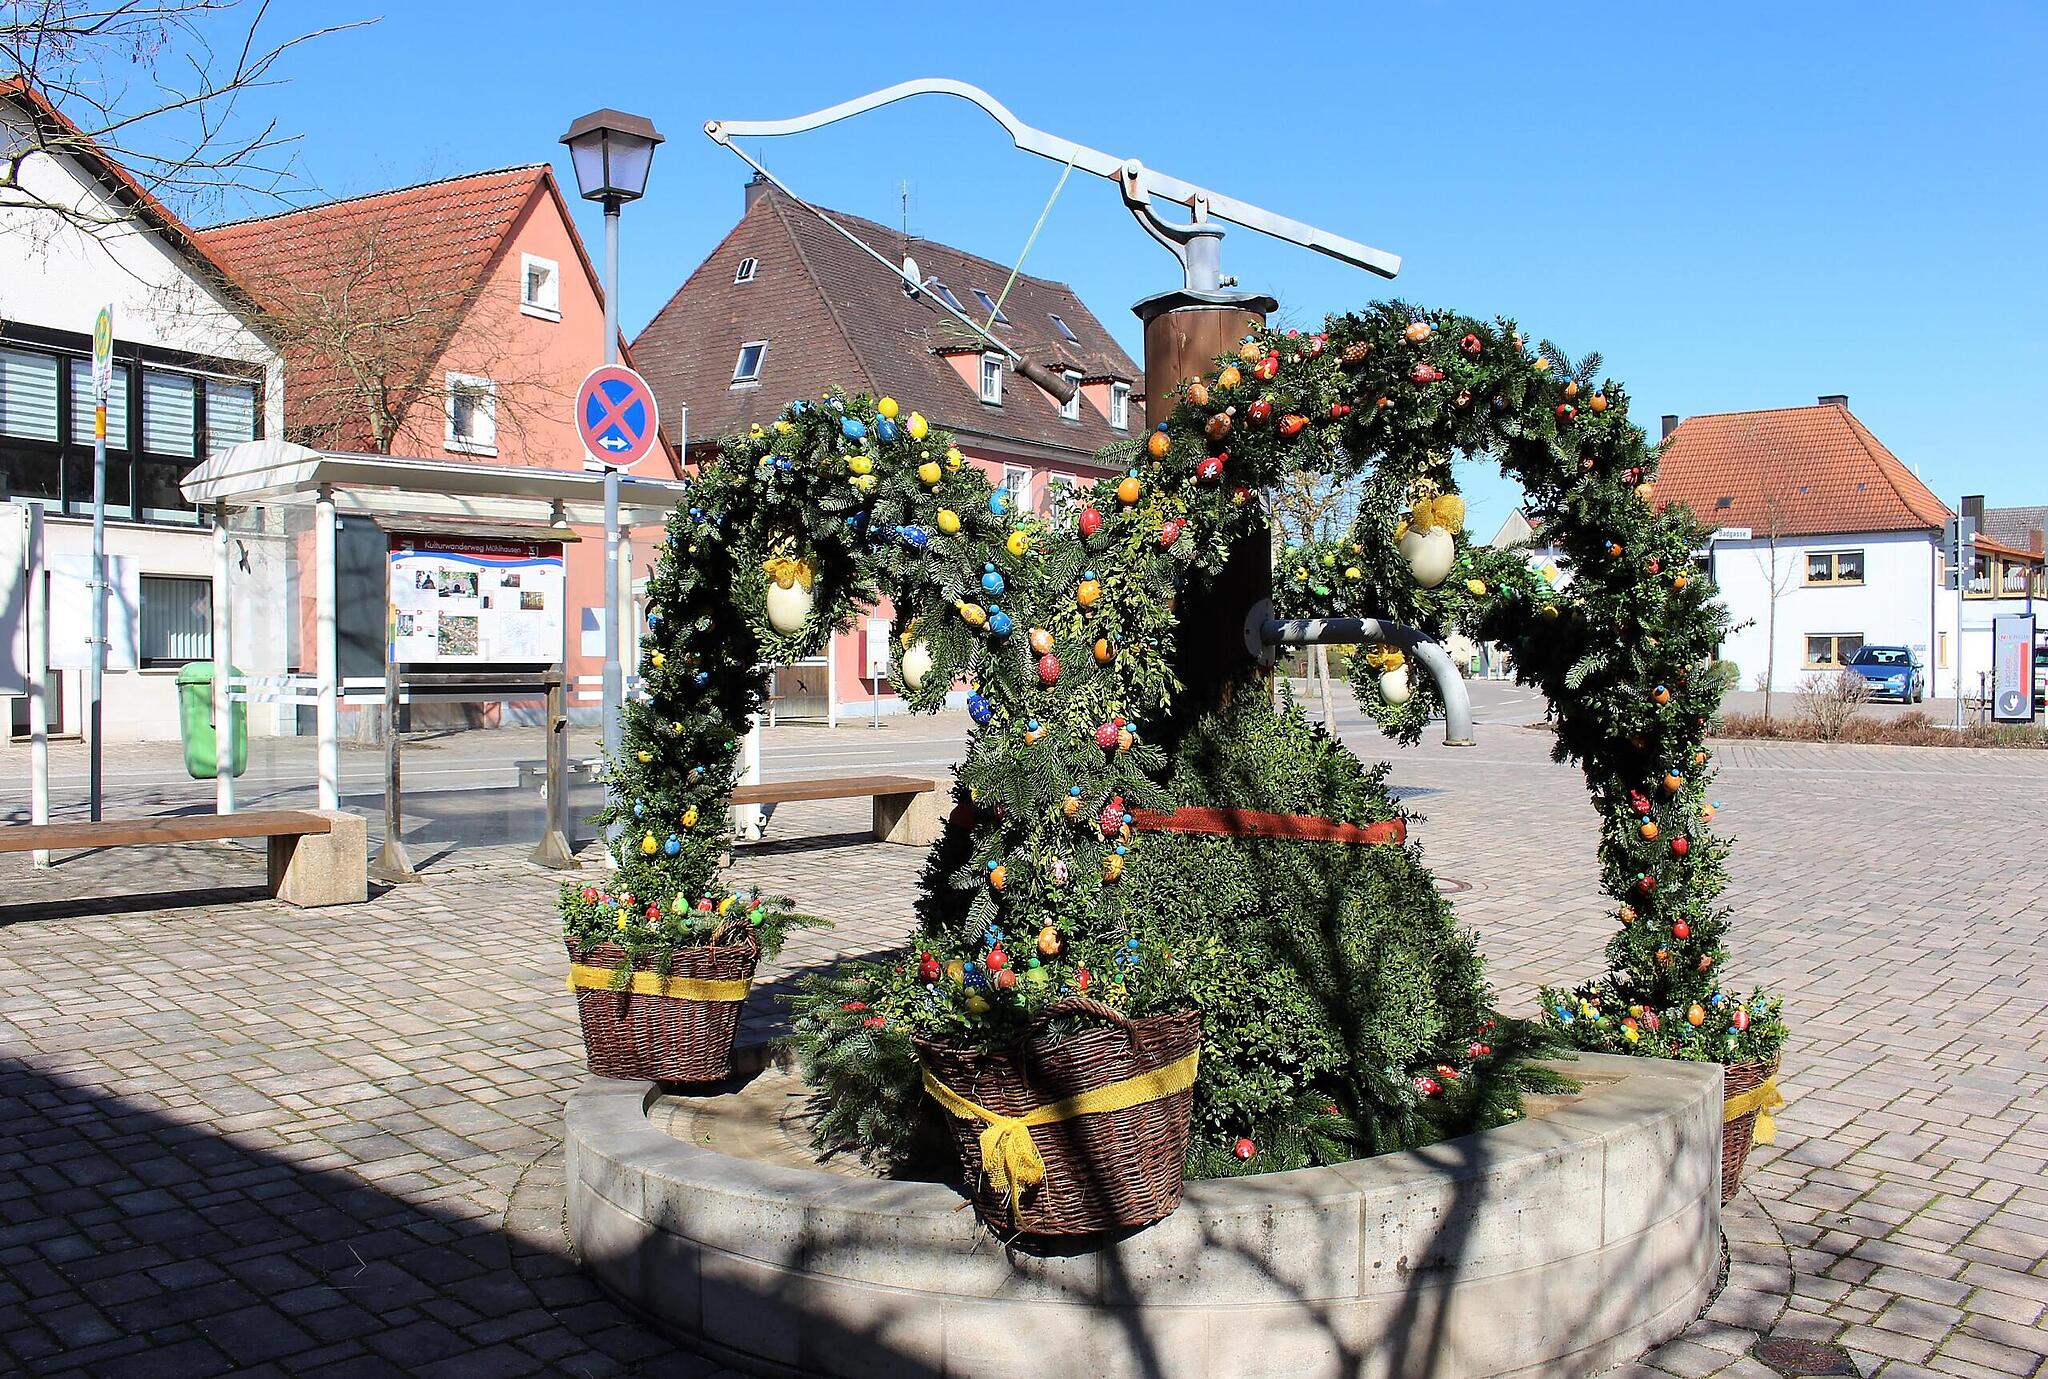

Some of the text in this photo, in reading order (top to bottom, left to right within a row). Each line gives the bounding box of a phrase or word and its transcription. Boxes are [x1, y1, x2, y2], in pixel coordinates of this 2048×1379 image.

[1718, 530, 1747, 538] Badgasse
[424, 540, 521, 554] Kulturwanderweg Mühlhausen
